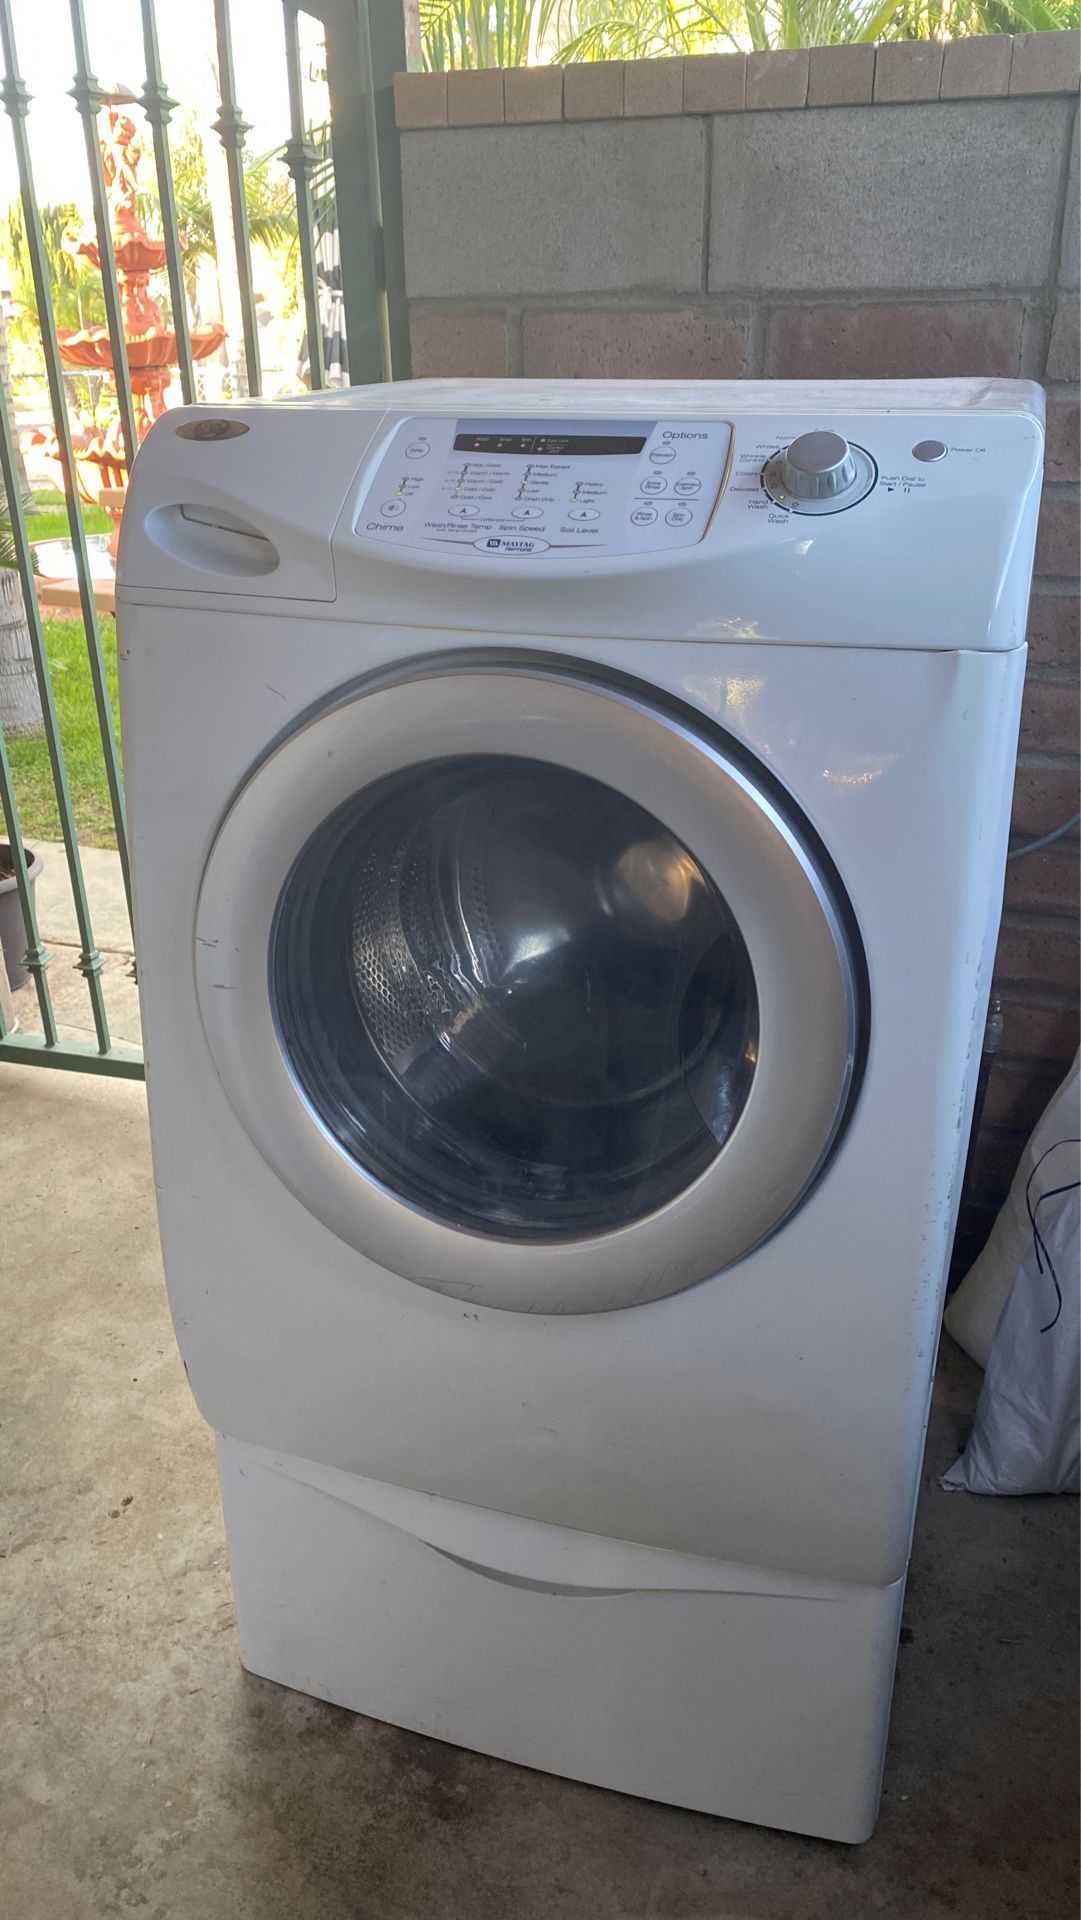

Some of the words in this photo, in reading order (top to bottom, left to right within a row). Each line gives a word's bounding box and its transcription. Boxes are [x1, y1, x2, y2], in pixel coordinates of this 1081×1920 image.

[662, 431, 709, 440] Options
[366, 522, 404, 532] Chime
[424, 521, 468, 529] Wash/Rinse
[471, 522, 492, 530] Temp
[518, 524, 545, 532] Speed
